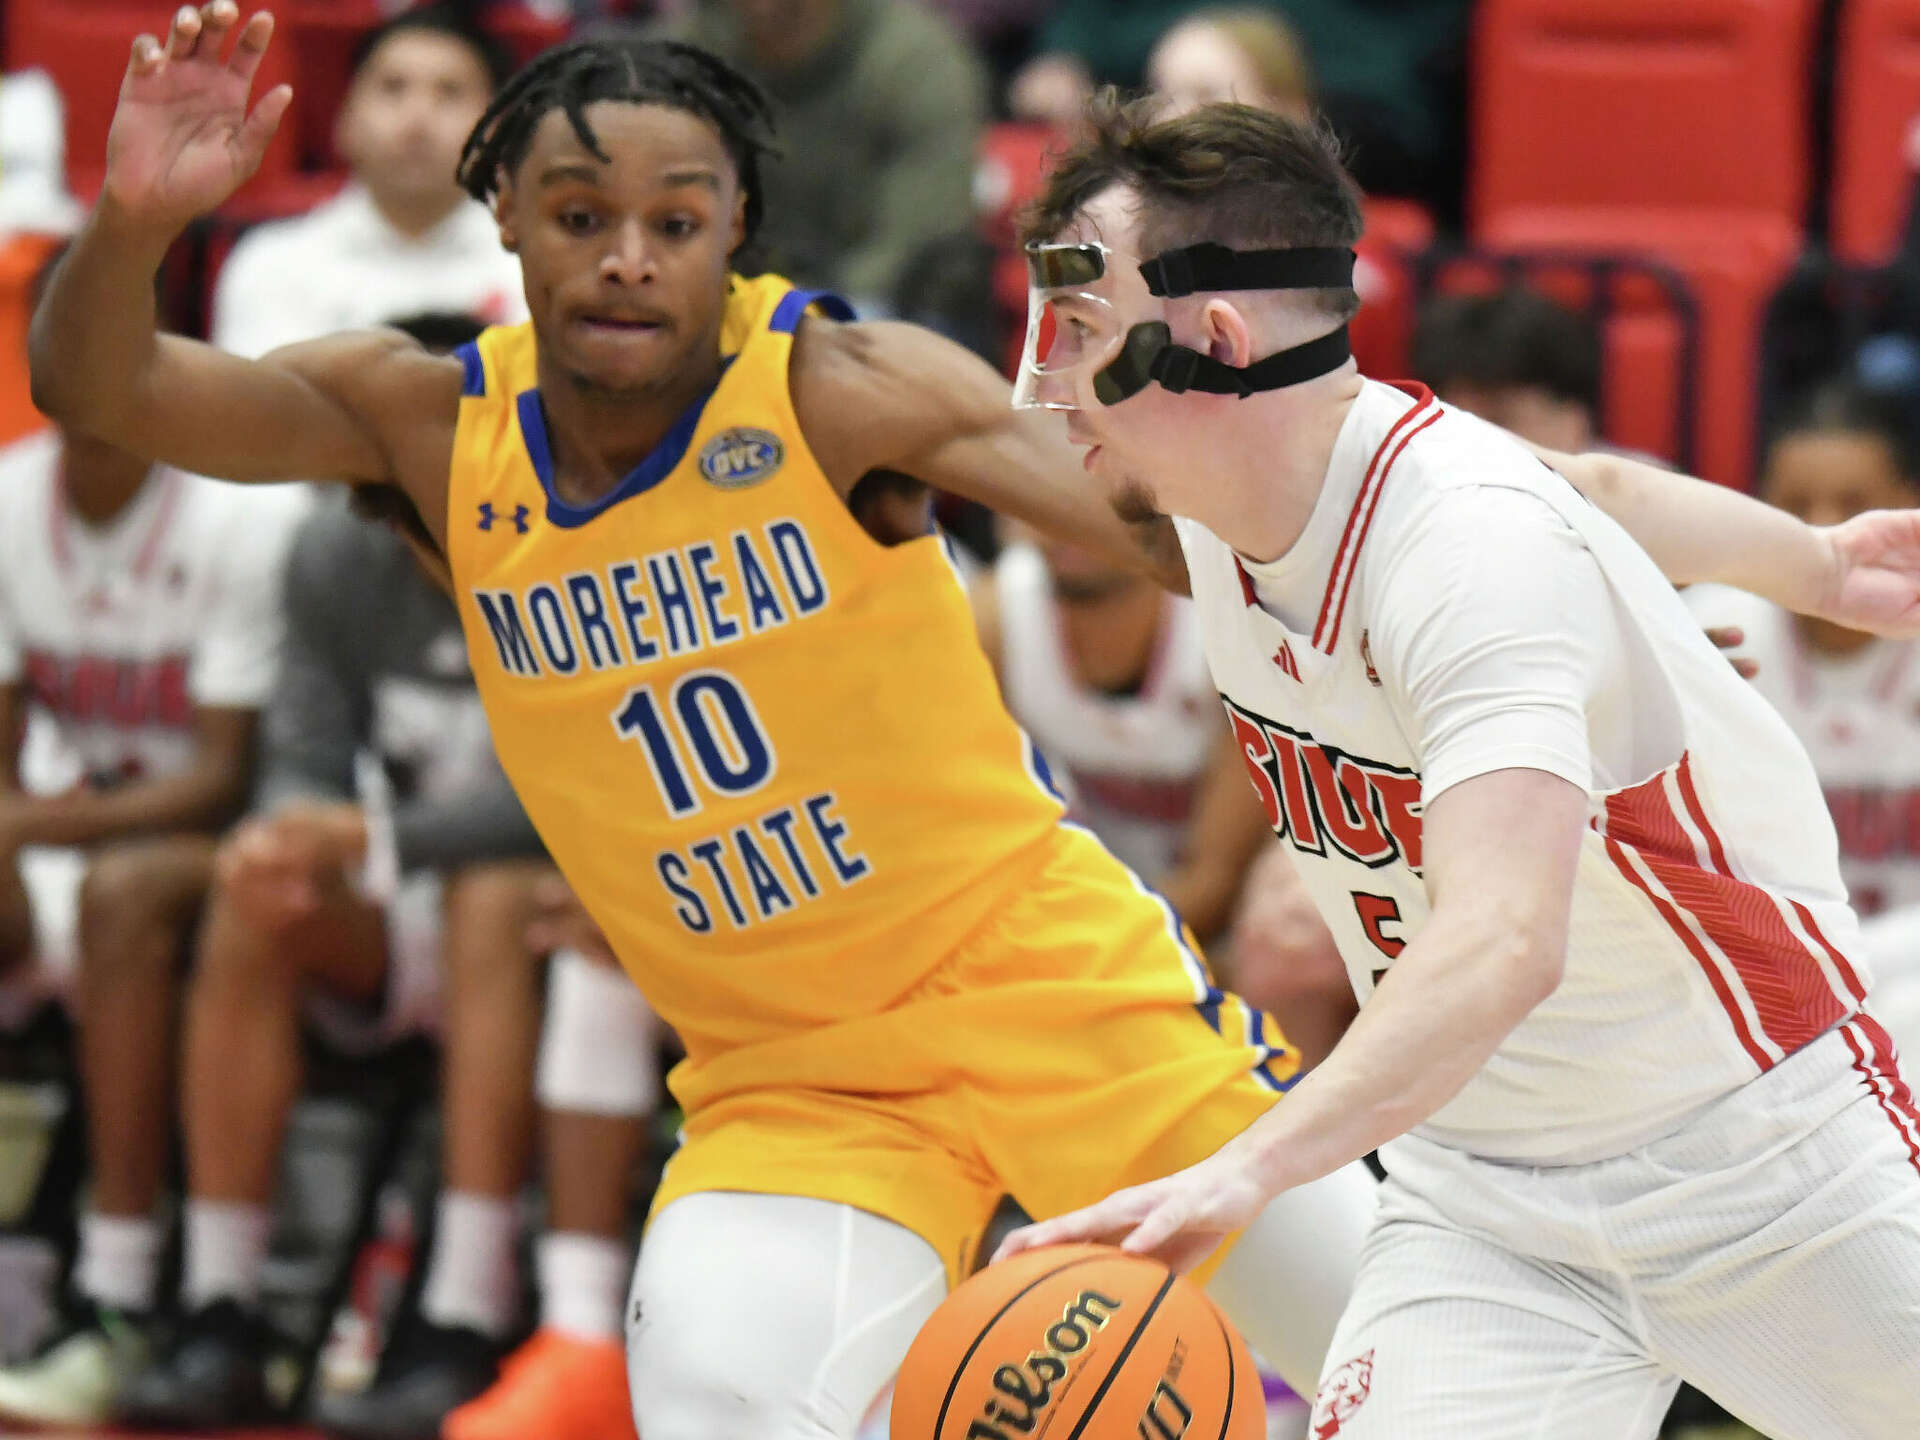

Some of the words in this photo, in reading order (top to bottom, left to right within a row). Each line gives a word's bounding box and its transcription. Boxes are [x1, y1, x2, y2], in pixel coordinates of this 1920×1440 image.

[475, 520, 828, 677] MOREHEAD
[615, 673, 774, 816] 10
[656, 793, 869, 935] STATE
[966, 1289, 1122, 1440] ilson
